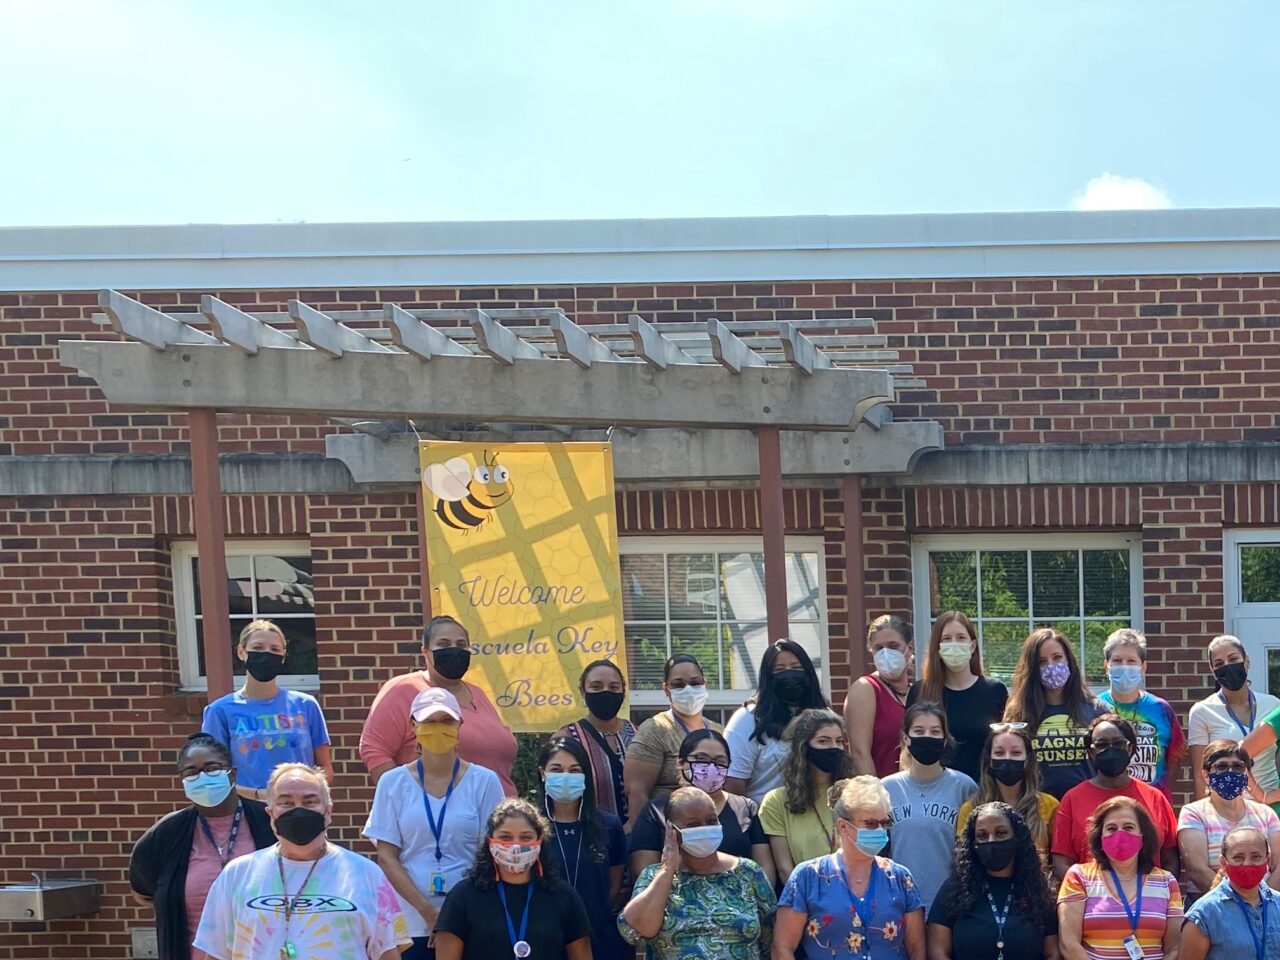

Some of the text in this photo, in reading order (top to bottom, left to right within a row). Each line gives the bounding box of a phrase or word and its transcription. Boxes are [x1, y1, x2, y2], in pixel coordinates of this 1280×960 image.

[459, 575, 585, 607] Welcome
[469, 626, 619, 660] scuela Key
[496, 678, 574, 708] Bees
[1031, 736, 1086, 749] RAGNA
[892, 803, 957, 825] EW YORK
[260, 897, 337, 909] OBX
